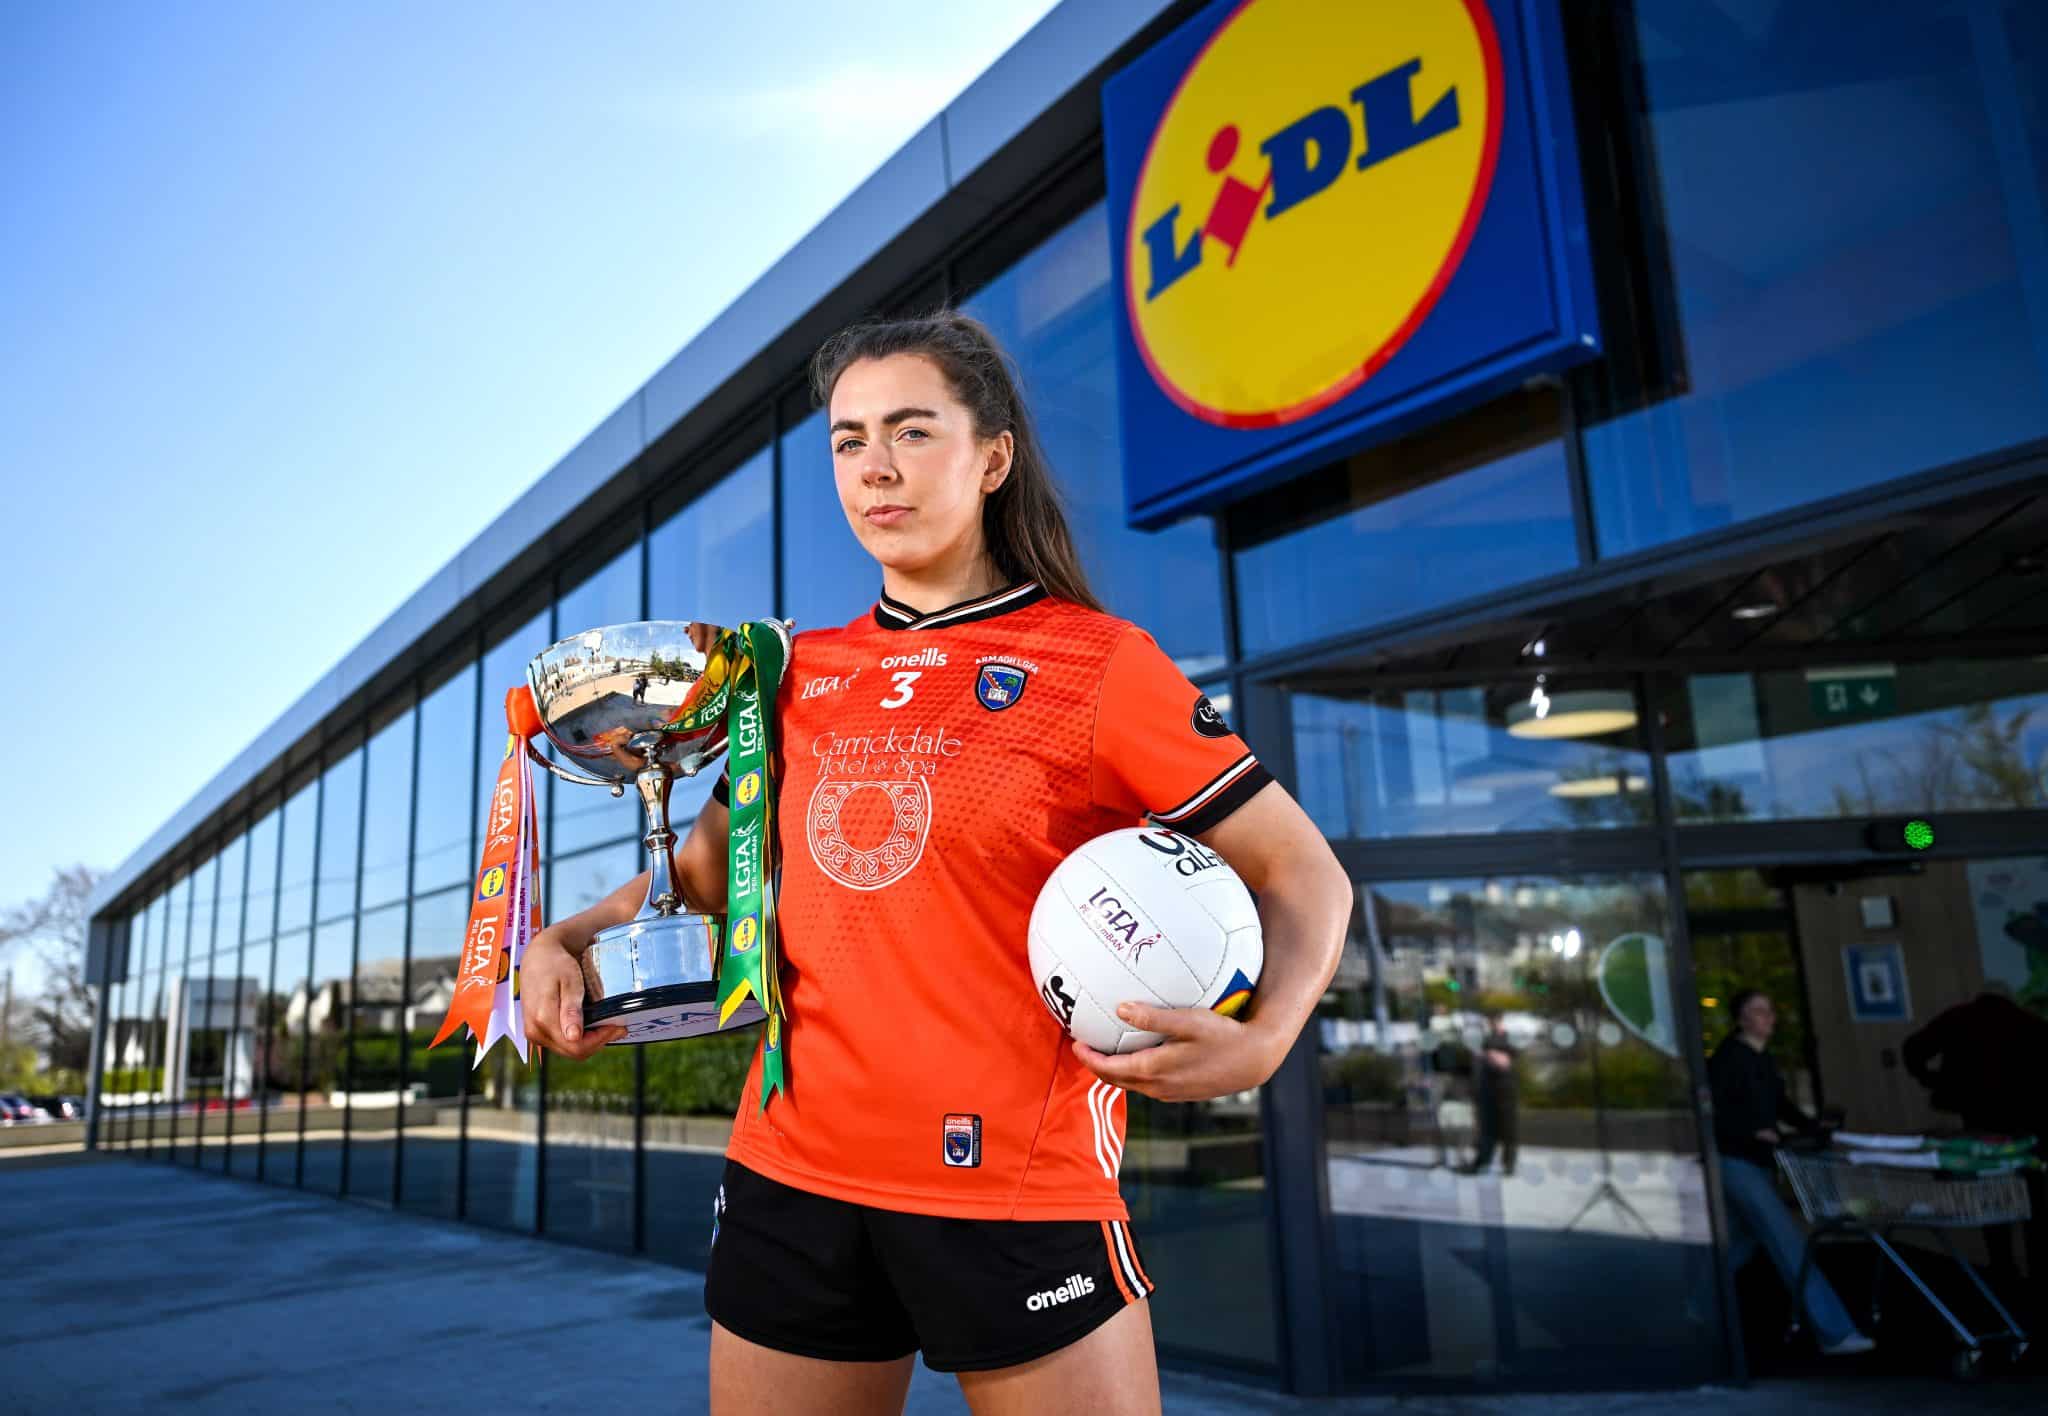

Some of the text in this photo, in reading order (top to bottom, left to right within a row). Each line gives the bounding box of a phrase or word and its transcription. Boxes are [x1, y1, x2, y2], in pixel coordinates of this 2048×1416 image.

[801, 676, 840, 700] LGFA
[879, 671, 923, 709] 3
[739, 701, 758, 758] LGFA
[812, 726, 962, 757] Carrickdale
[816, 754, 869, 775] Hotel
[894, 753, 936, 783] Spa
[497, 777, 514, 835] LGFA
[735, 836, 751, 900] LGFA
[1089, 886, 1139, 945] LGFA
[470, 915, 499, 975] LGFA
